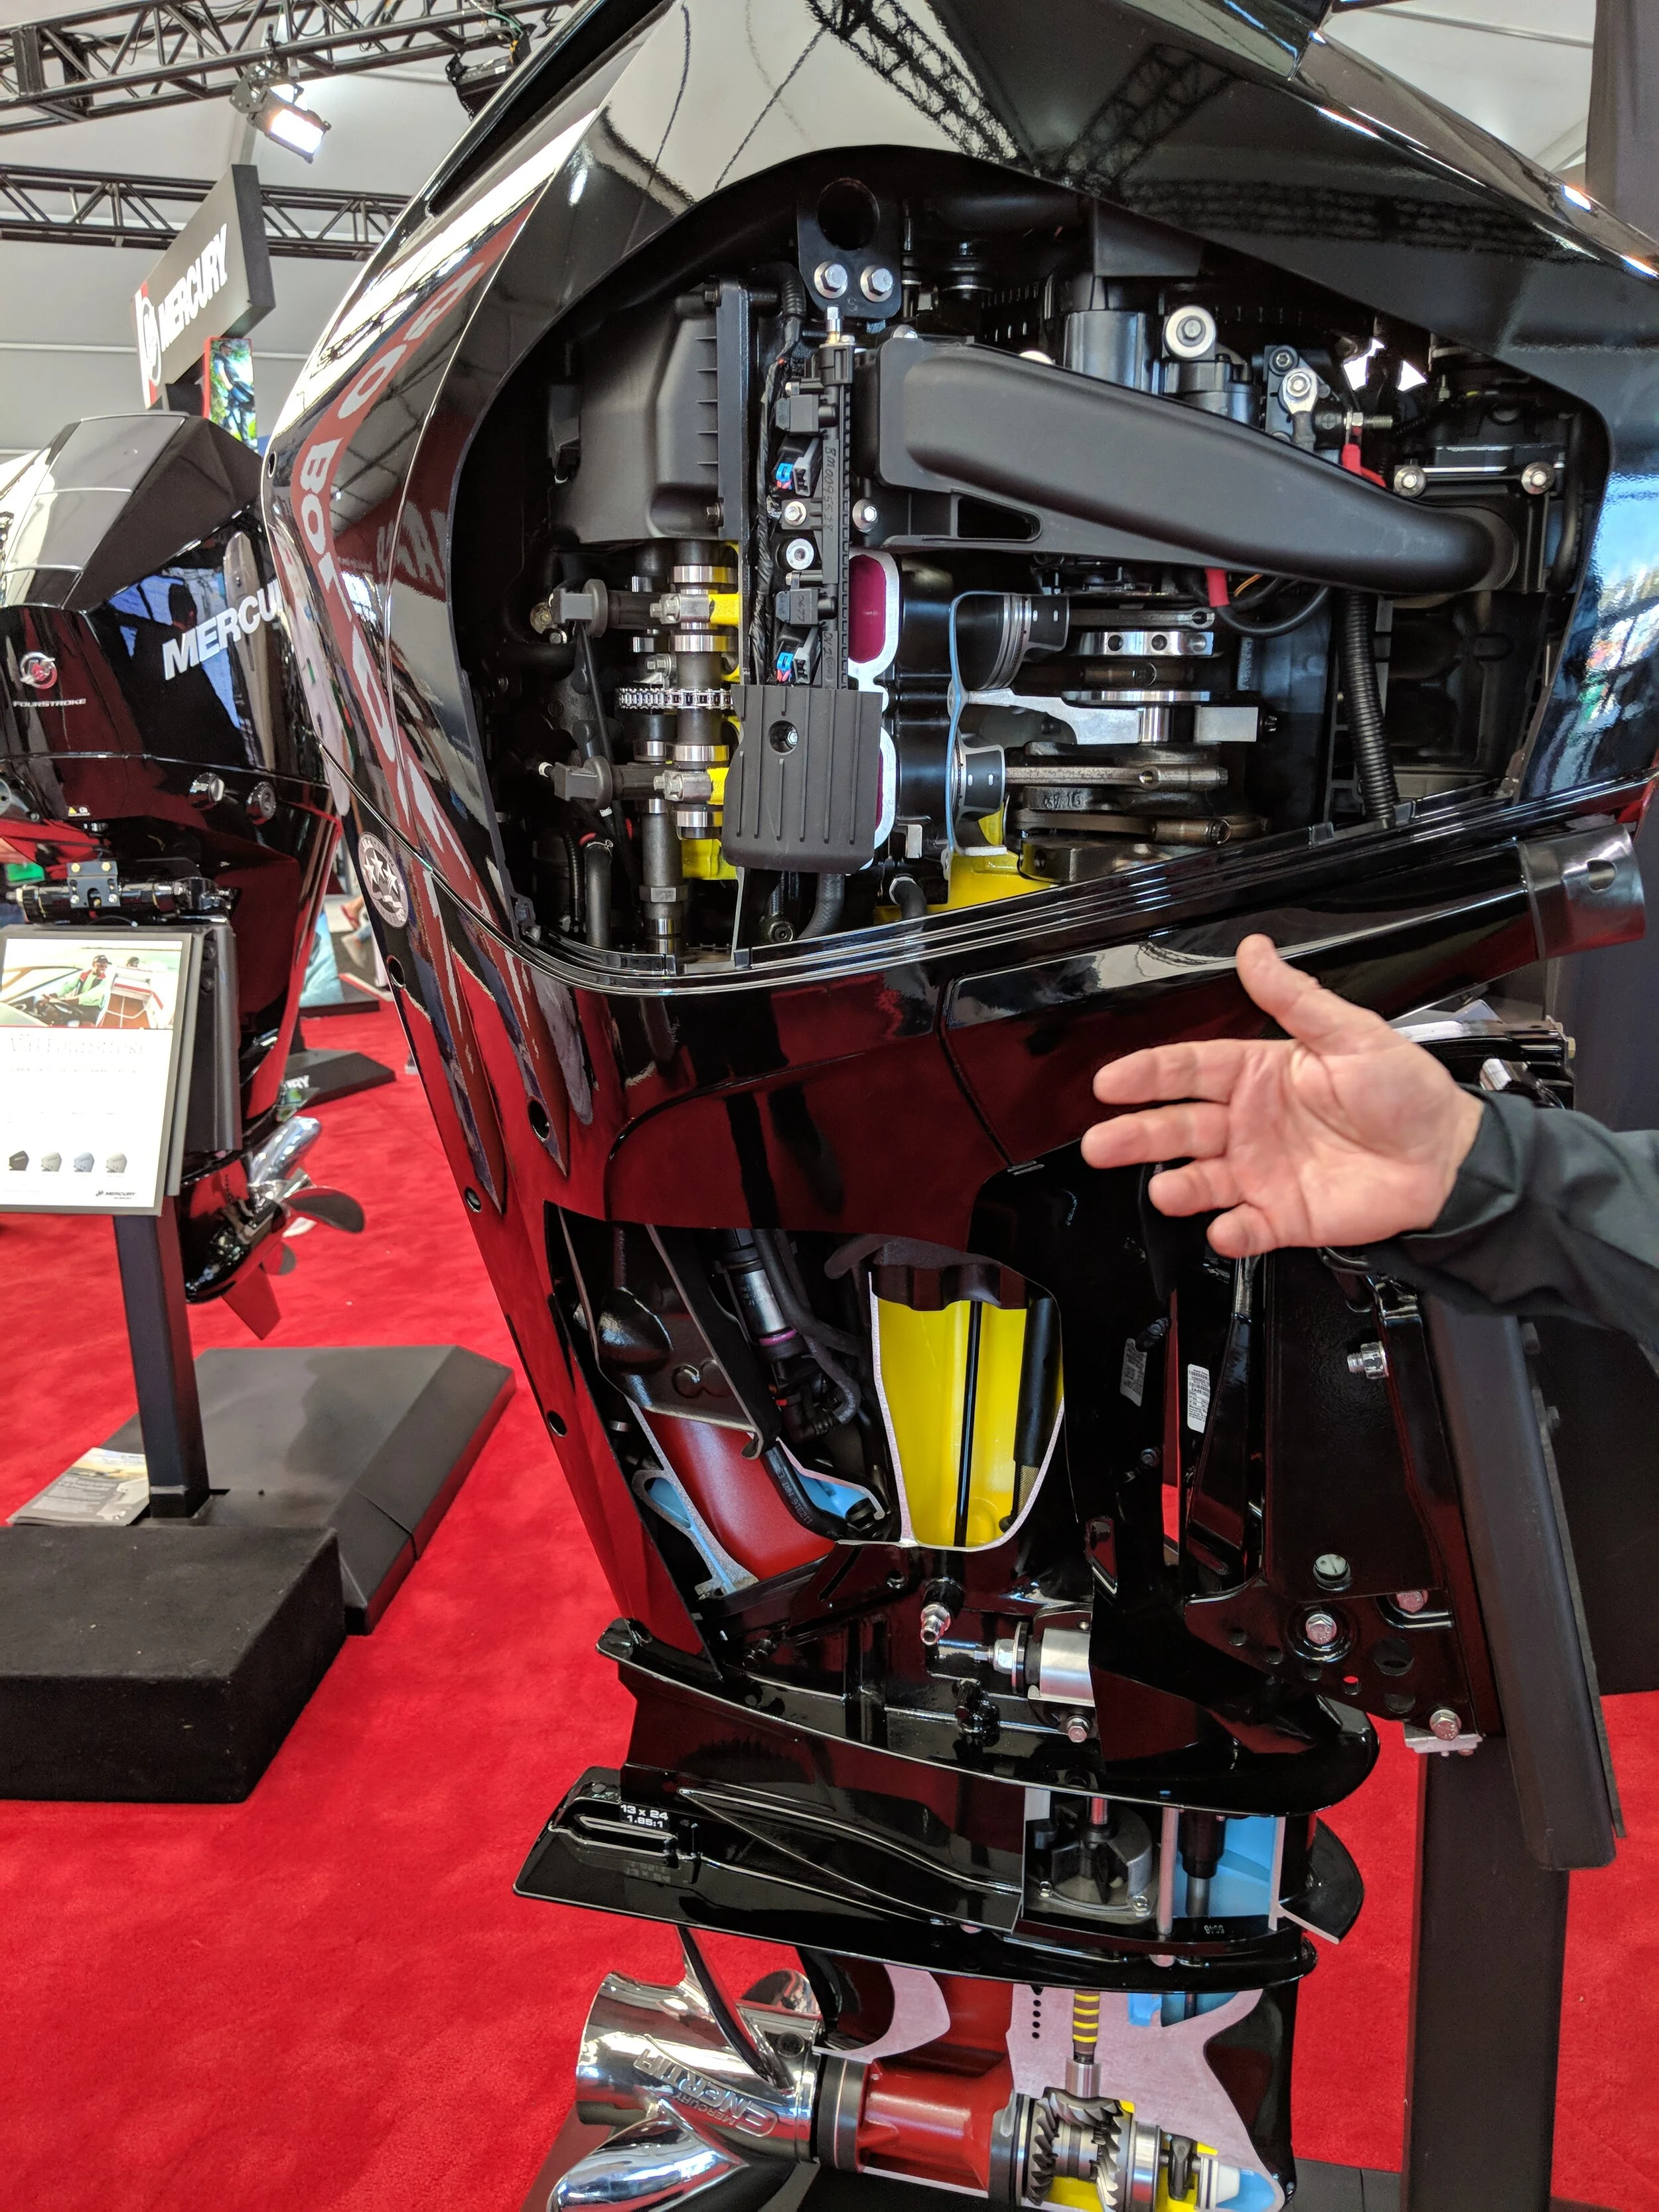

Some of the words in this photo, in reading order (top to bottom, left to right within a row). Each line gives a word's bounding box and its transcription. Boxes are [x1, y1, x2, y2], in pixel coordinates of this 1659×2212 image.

[158, 223, 227, 352] MERCURY
[13, 698, 86, 707] FOURSTROKE
[620, 1805, 636, 1814] 13
[650, 1809, 669, 1820] 24
[626, 1815, 663, 1828] 1.85:1
[632, 2049, 778, 2138] ENERTIA
[673, 2092, 735, 2126] MERCURY
